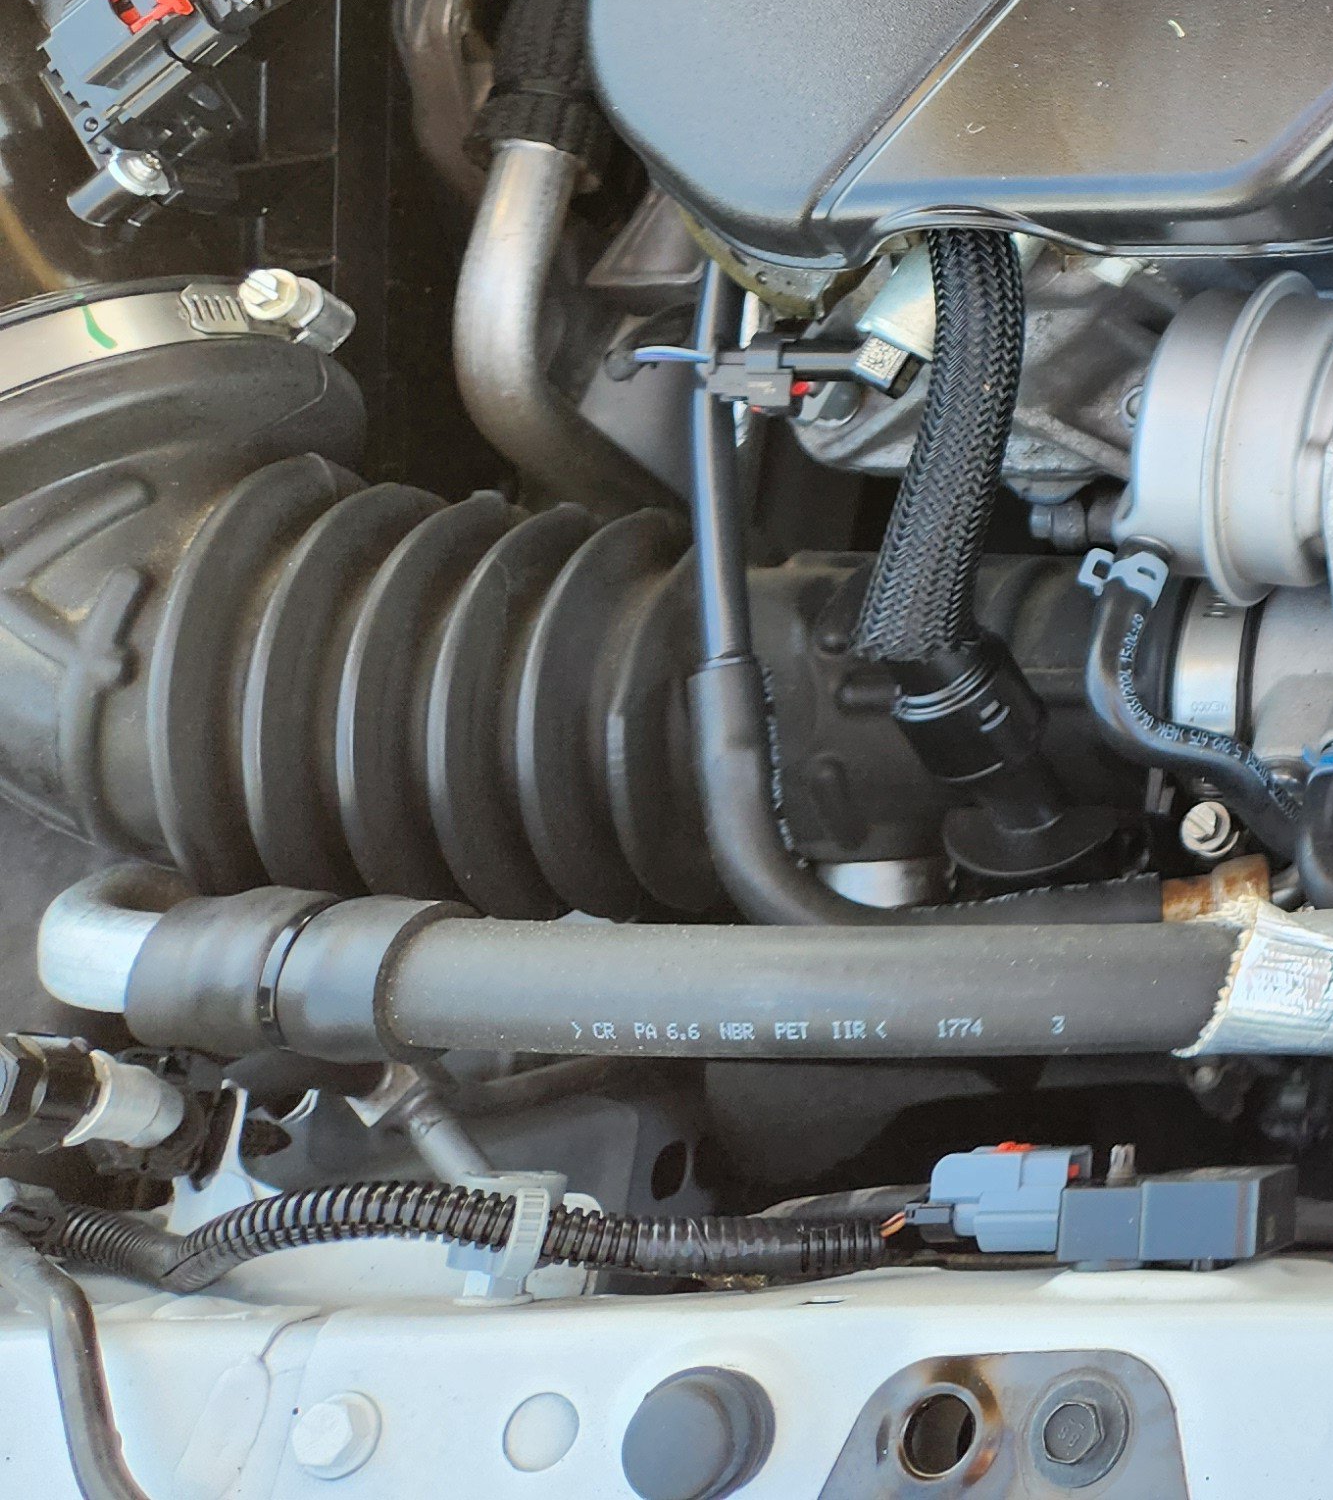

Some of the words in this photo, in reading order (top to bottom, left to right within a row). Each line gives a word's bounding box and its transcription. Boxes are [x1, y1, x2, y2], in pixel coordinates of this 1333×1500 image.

[633, 1021, 658, 1040] PA
[666, 1021, 701, 1041] 6.6
[718, 1020, 757, 1041] NBR
[774, 1019, 810, 1041] PET
[937, 1017, 984, 1039] 1774
